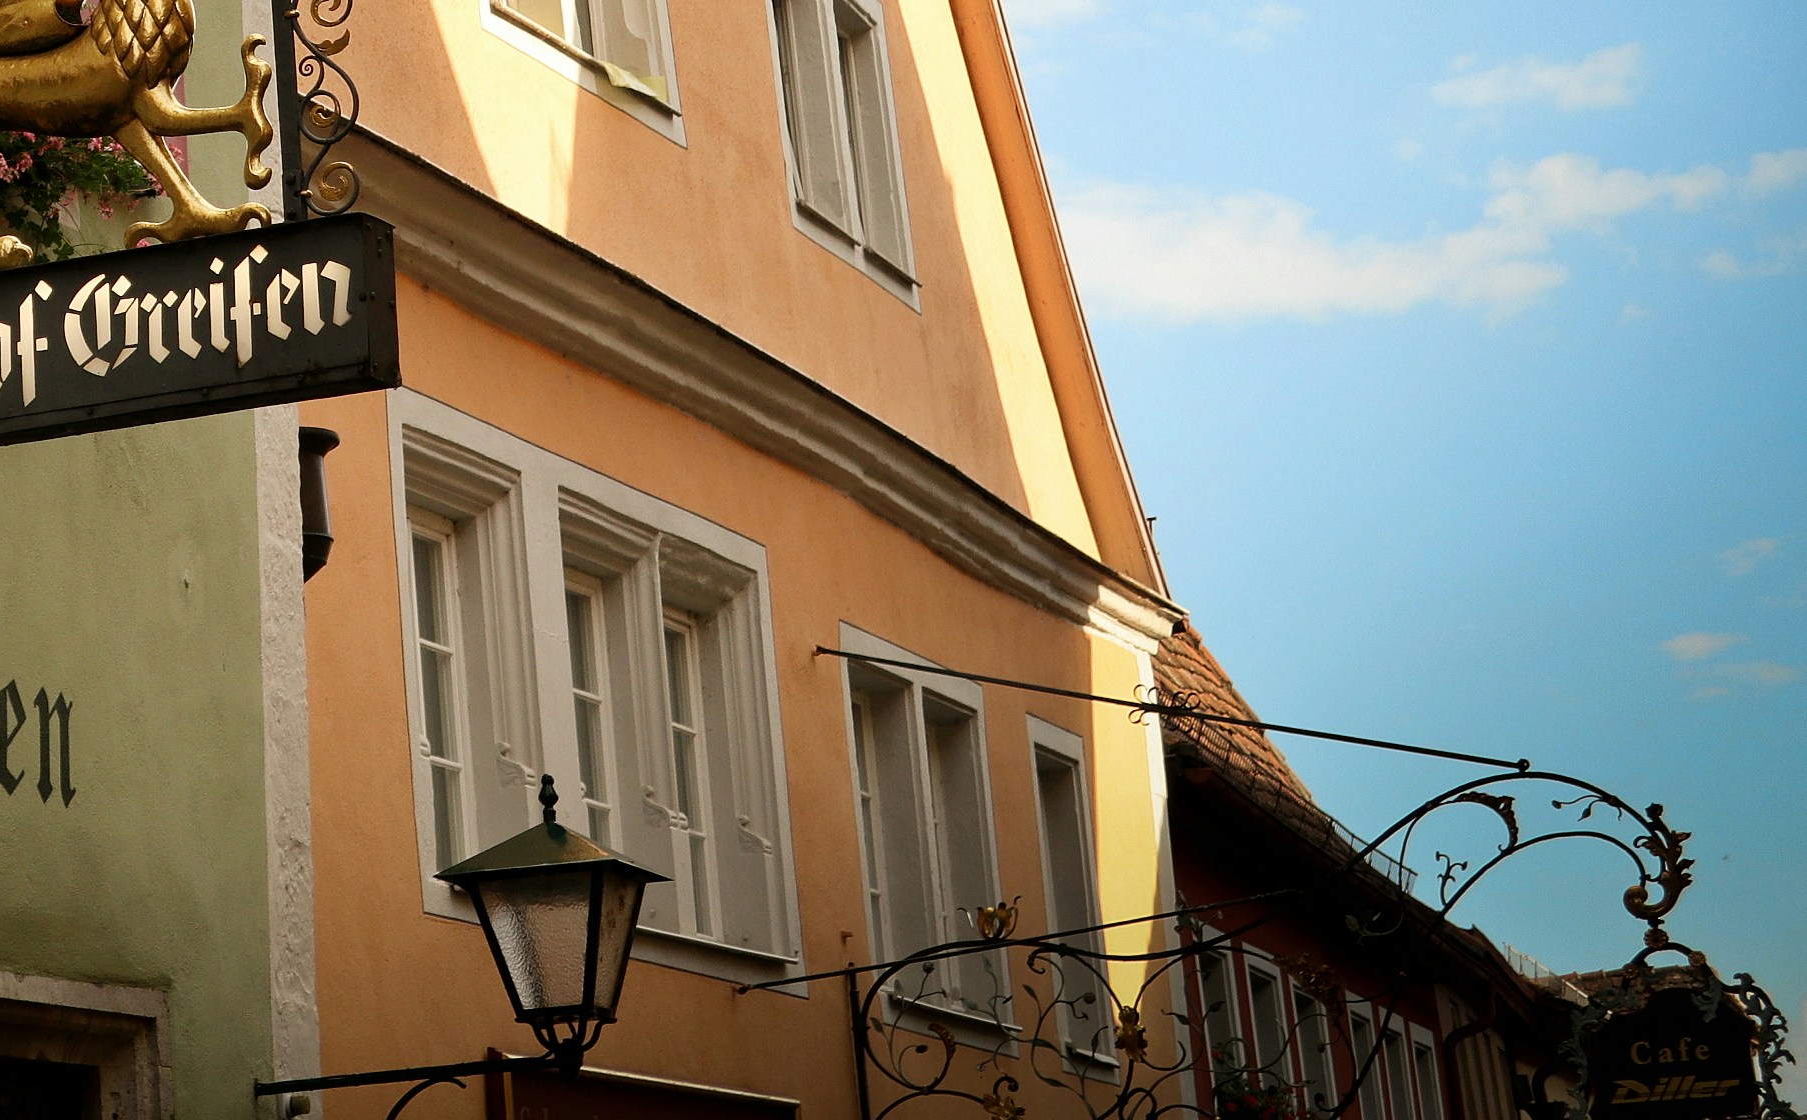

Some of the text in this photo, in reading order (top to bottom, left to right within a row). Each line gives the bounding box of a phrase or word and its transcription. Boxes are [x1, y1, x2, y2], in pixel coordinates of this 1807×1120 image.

[64, 245, 352, 377] Greifen
[1630, 1037, 1710, 1064] Cafe
[1610, 1075, 1740, 1105] Diller
